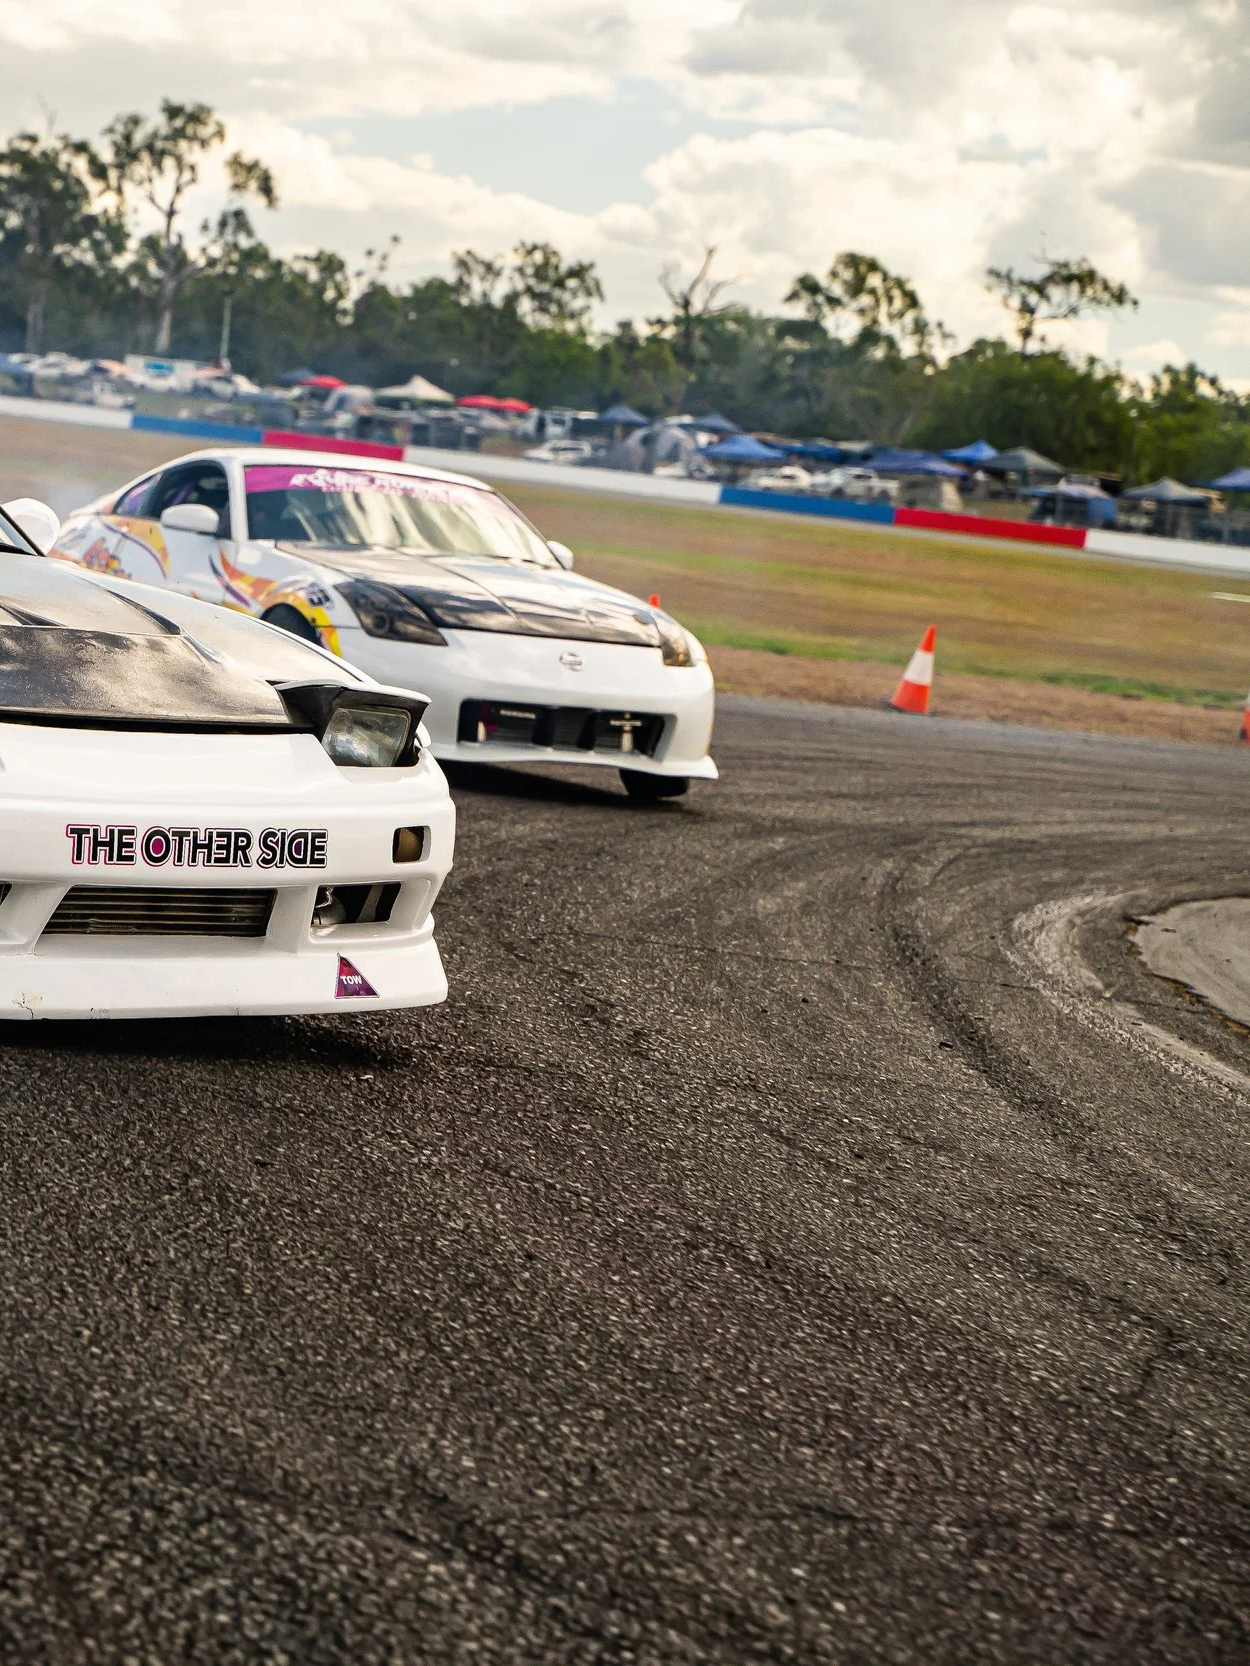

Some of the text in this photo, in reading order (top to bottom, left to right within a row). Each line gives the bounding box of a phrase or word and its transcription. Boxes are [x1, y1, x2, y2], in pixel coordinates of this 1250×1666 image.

[67, 824, 328, 868] THE OTHER SIDE
[340, 975, 362, 985] TOW
